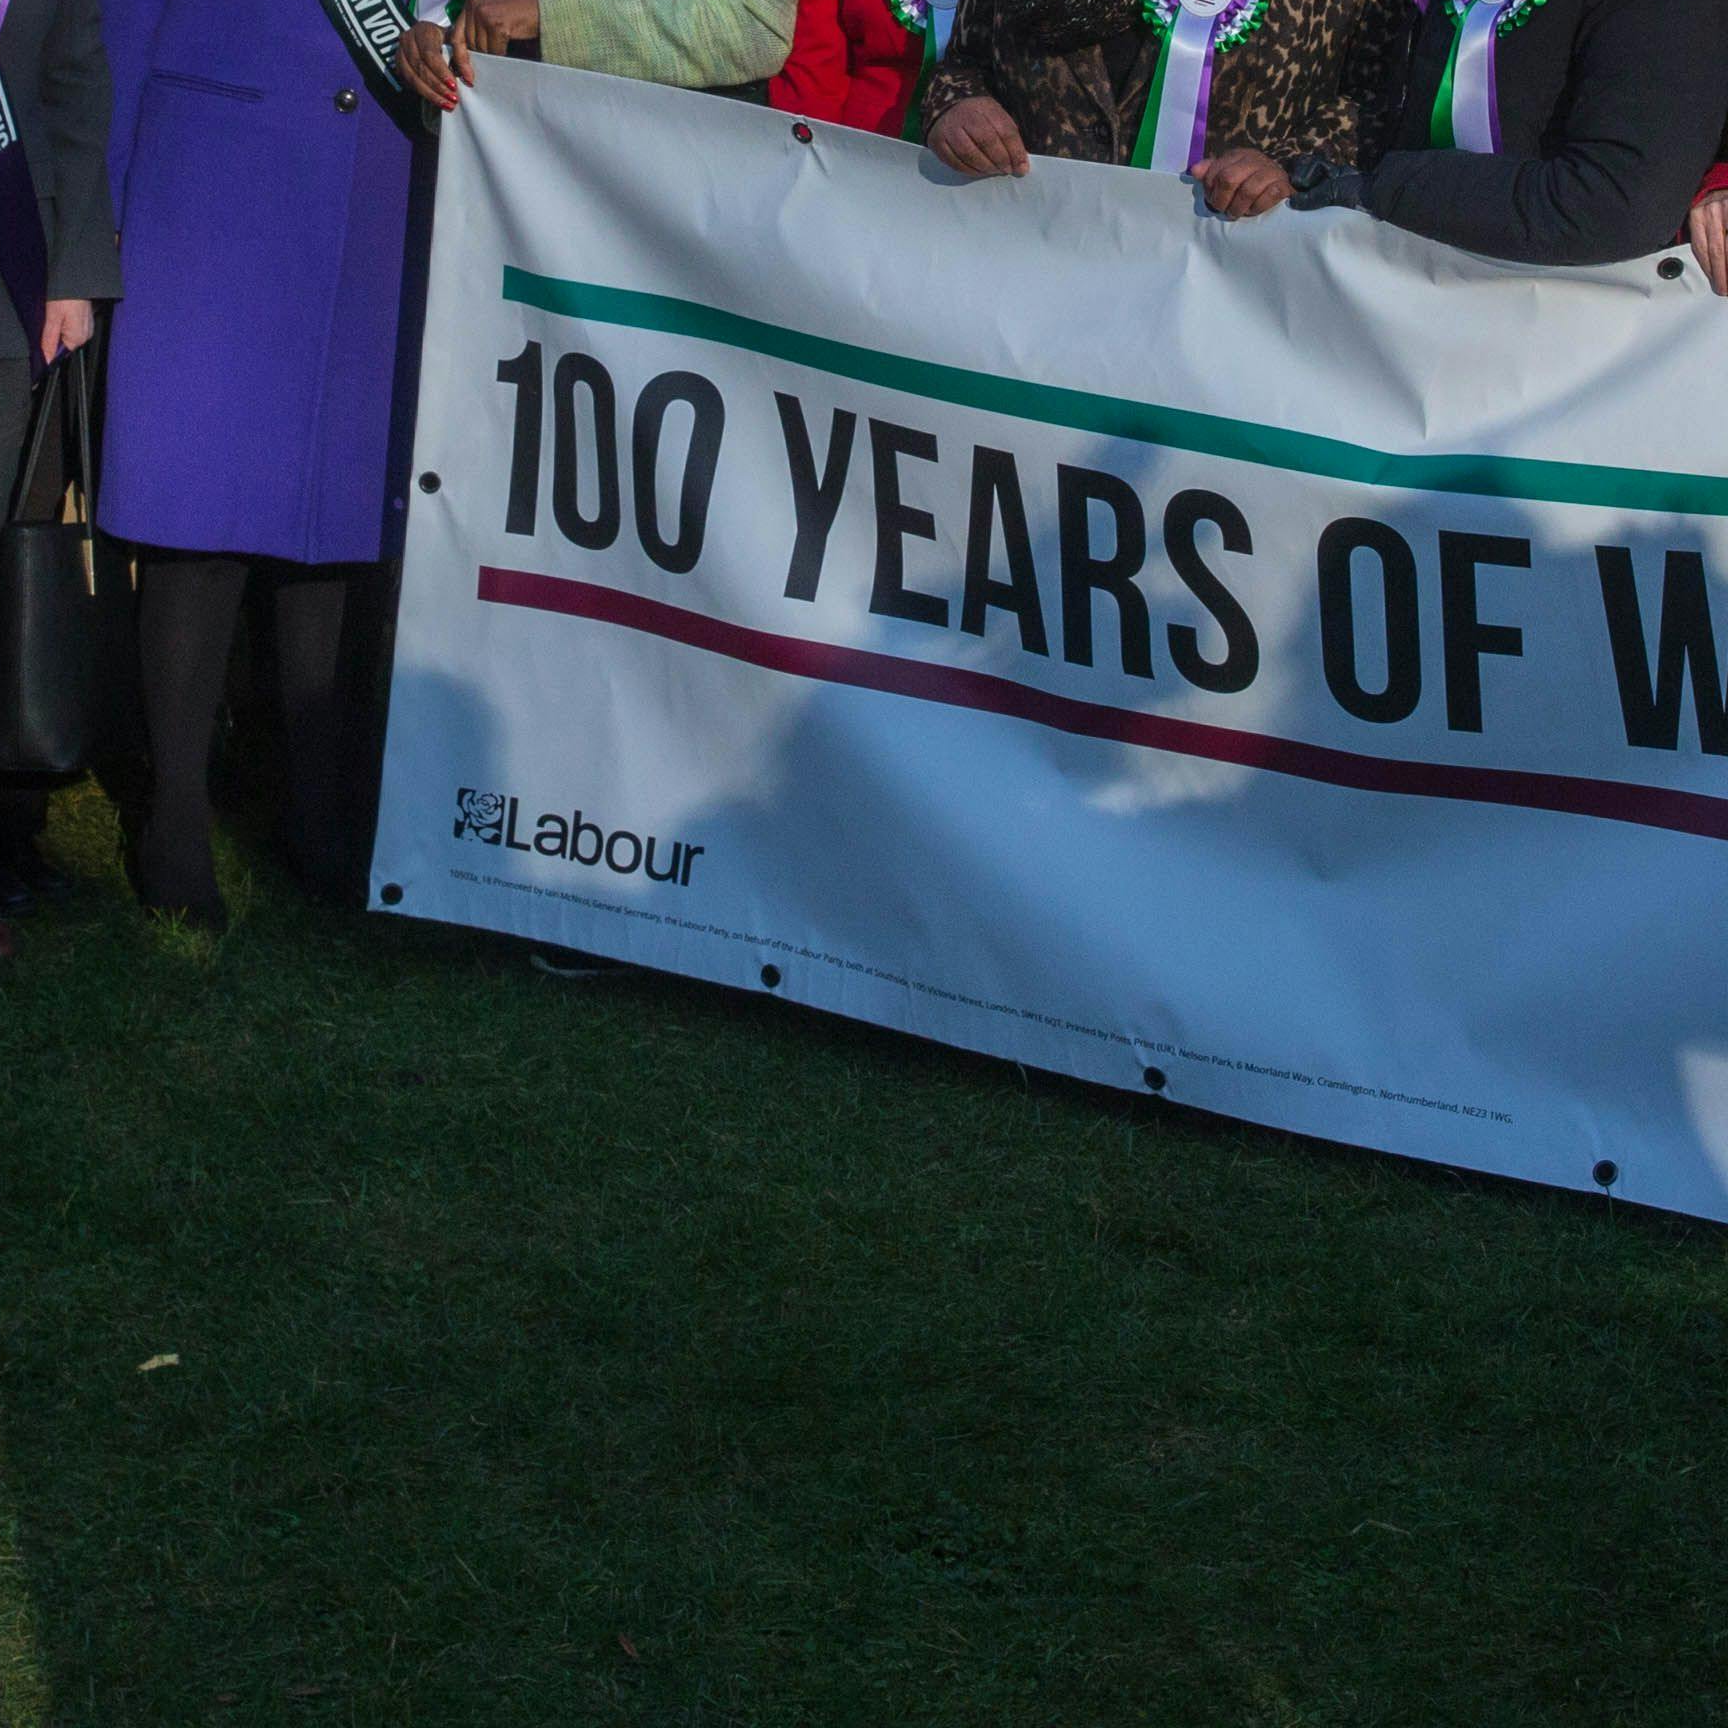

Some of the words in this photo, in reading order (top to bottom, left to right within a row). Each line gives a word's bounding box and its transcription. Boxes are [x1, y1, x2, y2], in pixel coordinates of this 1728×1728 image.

[495, 340, 726, 574] 100
[773, 390, 1260, 695] YEARS
[1315, 515, 1532, 735] OF
[505, 796, 705, 887] Labour
[493, 877, 532, 894] Promoted
[533, 886, 543, 897] by
[592, 899, 621, 913] General
[679, 919, 706, 932] Labour
[732, 932, 743, 941] on
[772, 940, 782, 950] of
[782, 942, 794, 953] the
[795, 946, 822, 960] Labour
[1179, 1048, 1210, 1064] Nelson
[1236, 1061, 1242, 1070] 6
[1244, 1062, 1291, 1080] Moorland
[1317, 1076, 1376, 1097] Cramlington,
[1379, 1089, 1459, 1114] Northumberland,
[1462, 1106, 1487, 1119] NE23
